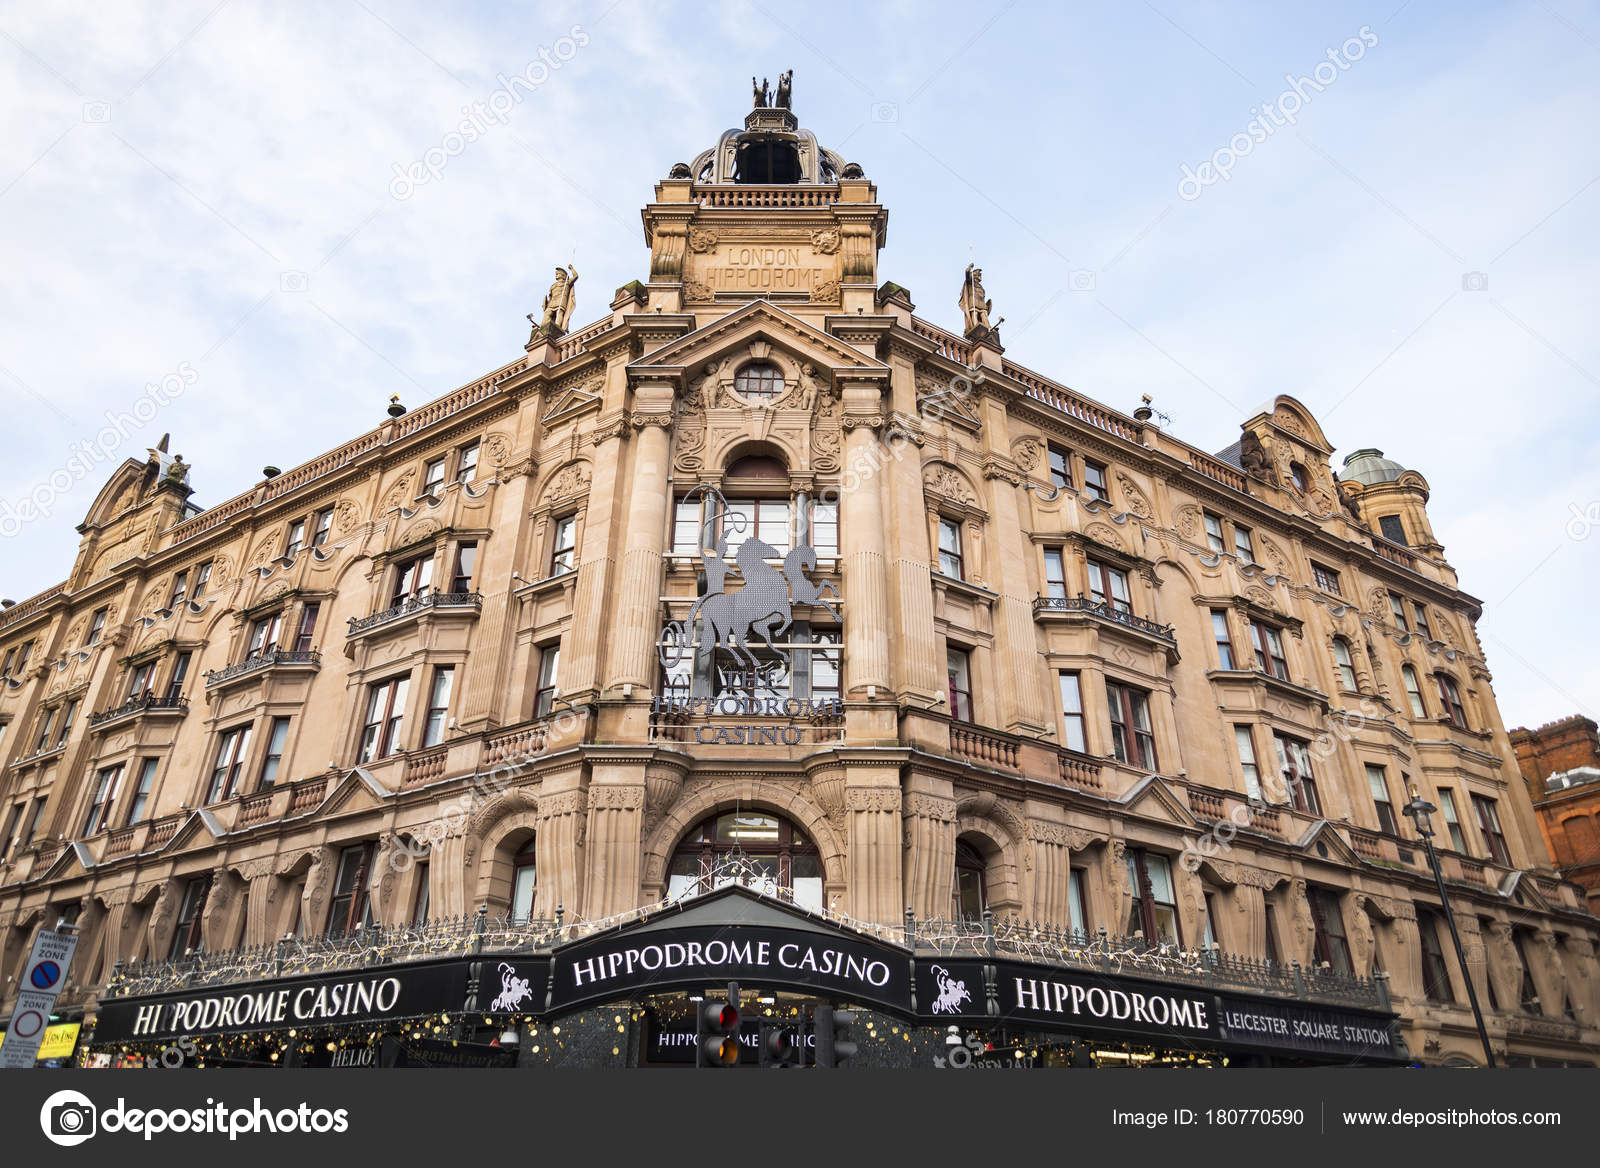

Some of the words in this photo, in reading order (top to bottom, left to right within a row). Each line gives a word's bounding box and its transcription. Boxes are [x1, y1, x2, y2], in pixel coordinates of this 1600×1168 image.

[727, 248, 800, 266] LONDON
[706, 268, 823, 288] HIPPODROME
[723, 671, 777, 689] THE
[654, 696, 844, 716] HIPPODROME
[695, 725, 802, 745] CASINO
[38, 949, 66, 961] ZONE
[573, 940, 770, 987] HIPPODROME
[778, 944, 890, 987] CASINO
[23, 1000, 47, 1010] ZONE
[293, 977, 402, 1020] CASINO
[1014, 977, 1209, 1030] HIPPODROME
[1226, 1010, 1290, 1035] LEICESTER
[1293, 1020, 1341, 1041] SQUARE
[1344, 1026, 1391, 1046] STATION
